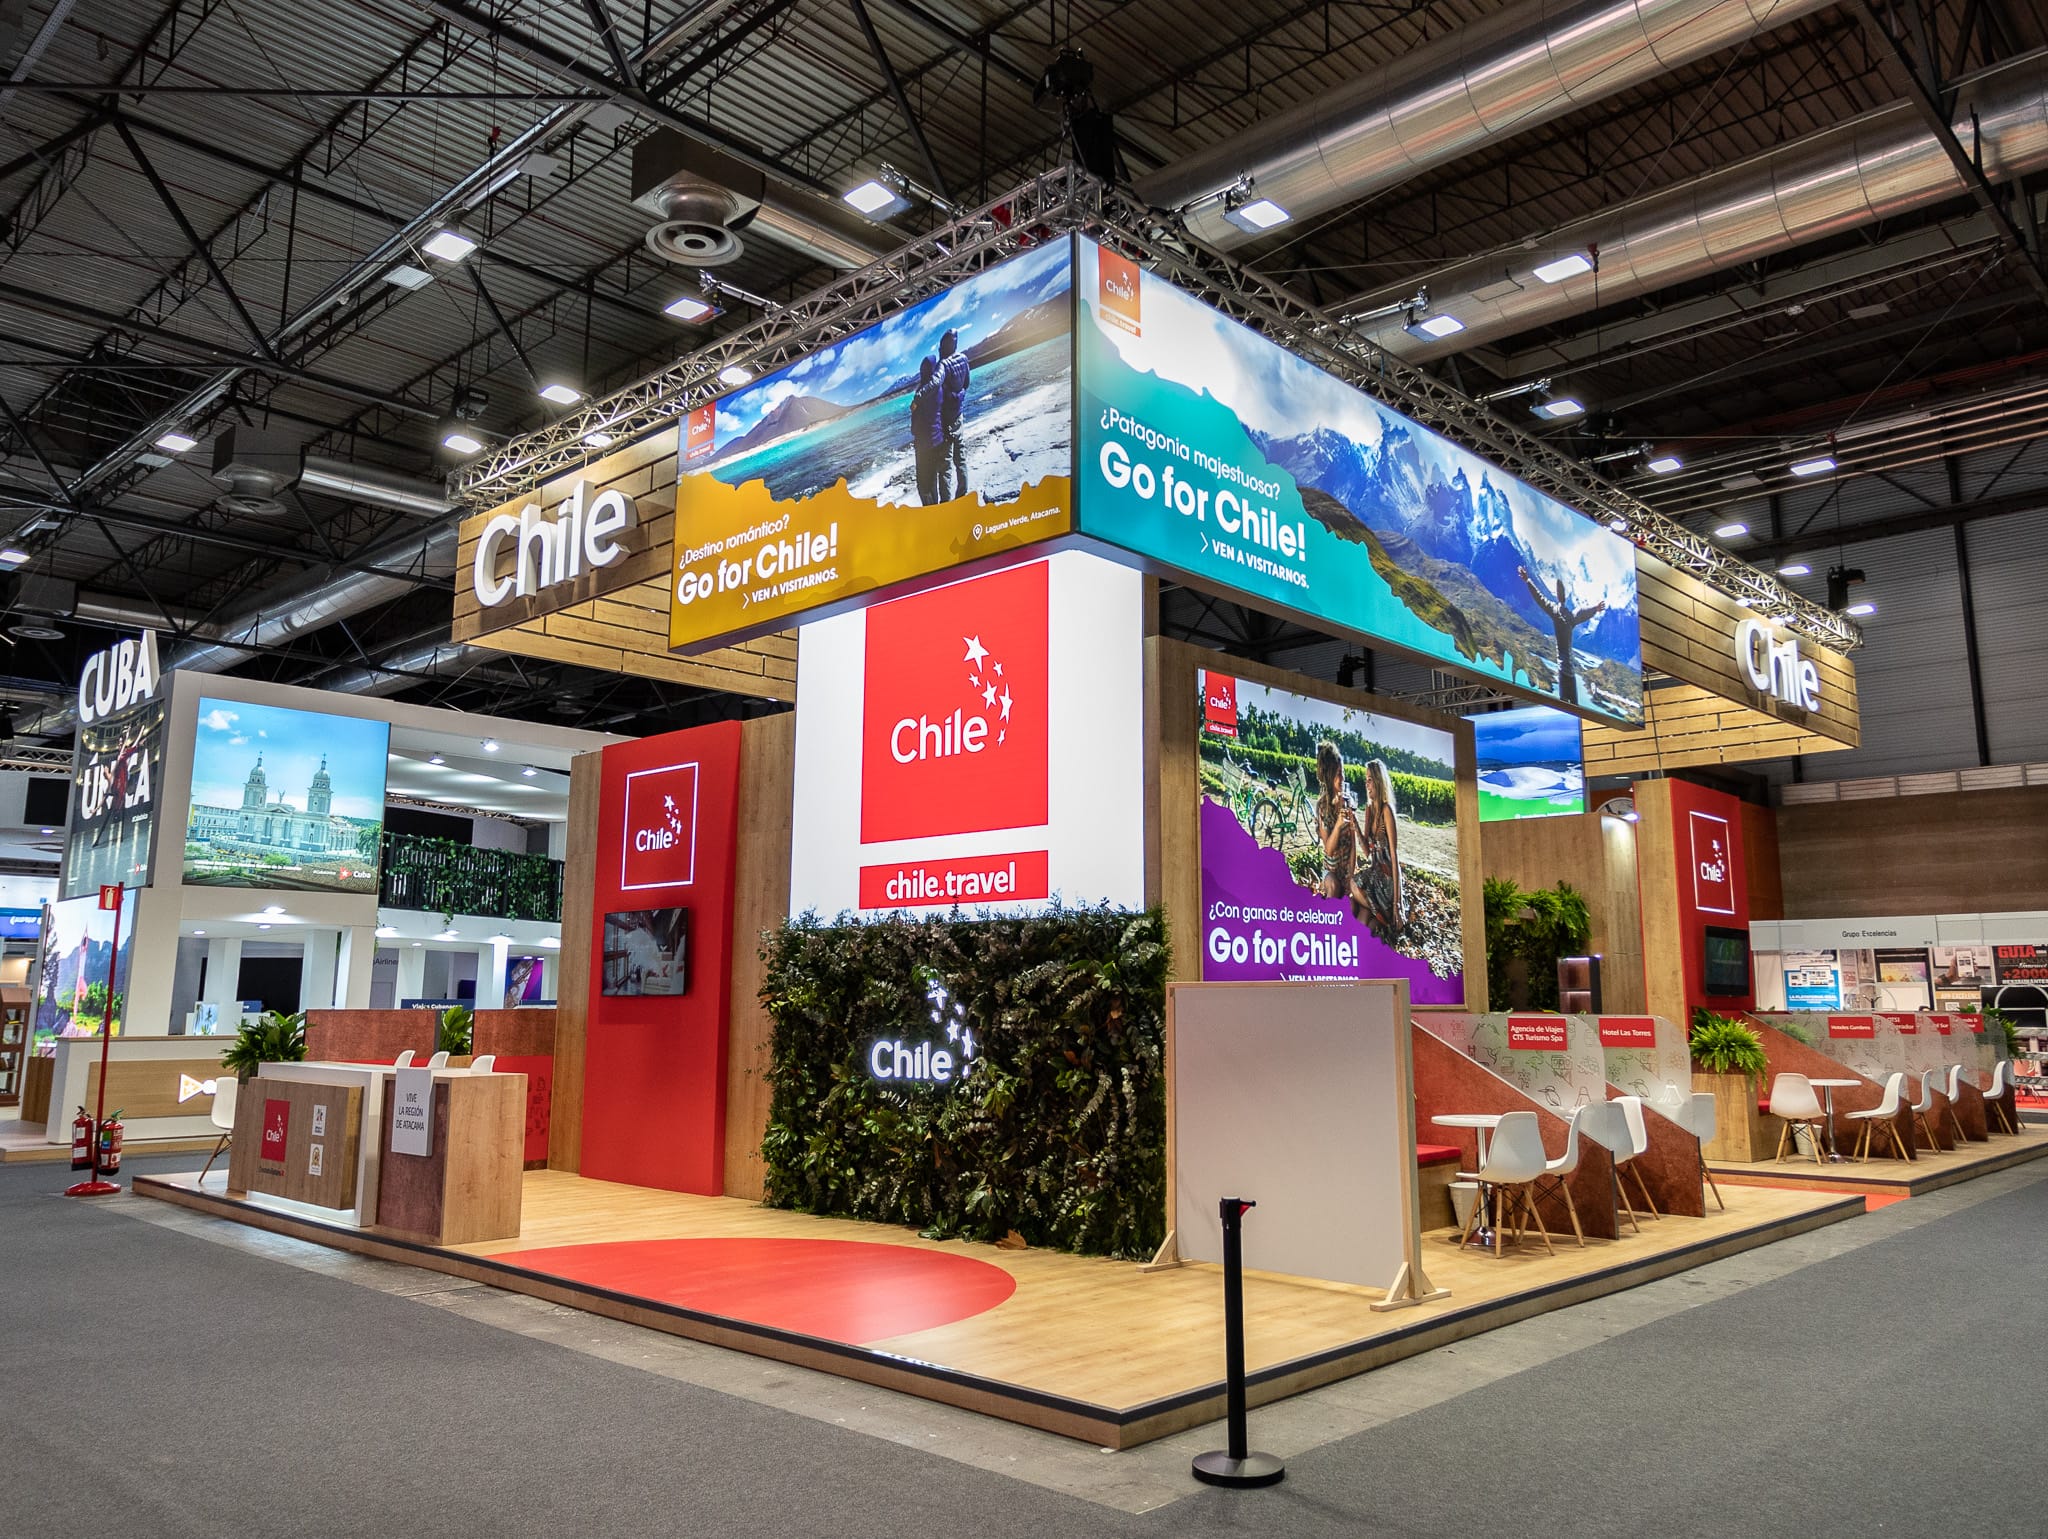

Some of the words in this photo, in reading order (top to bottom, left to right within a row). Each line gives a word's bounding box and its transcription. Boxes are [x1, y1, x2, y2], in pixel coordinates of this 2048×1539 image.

[1105, 279, 1130, 301] Chile
[691, 422, 708, 436] Chile
[1100, 407, 1190, 461] ¿Patagonia
[1193, 449, 1281, 501] majestuosa?
[1100, 441, 1156, 500] Go
[1162, 465, 1209, 522] for
[1215, 490, 1306, 562] Chile!
[985, 521, 1009, 534] Laguna
[1008, 515, 1030, 527] Verde,
[1030, 507, 1061, 521] Atacama.
[474, 480, 634, 608] Chile
[679, 540, 724, 570] ¿Destino
[725, 513, 790, 550] romántico?
[677, 571, 714, 605] Go
[717, 559, 753, 593] for
[756, 522, 839, 579] Chile!
[1212, 539, 1235, 561] VEN
[1236, 549, 1245, 565] A
[1246, 554, 1310, 590] VISITARNOS.
[752, 589, 772, 603] VEN
[771, 589, 779, 600] A
[779, 568, 839, 595] VISITARNOS.
[79, 629, 153, 723] CUBA
[1736, 619, 1820, 712] Chile
[1210, 696, 1228, 710] Chile
[890, 707, 989, 764] Chile
[1209, 724, 1234, 735] chile.travel
[81, 748, 151, 821] ÚNCA
[635, 827, 674, 852] Chile
[353, 870, 372, 879] Cuba
[886, 861, 1016, 901] chile.travel
[1700, 862, 1723, 883] Chile
[1209, 901, 1240, 921] ¿Con
[1242, 907, 1278, 924] ganas
[1279, 906, 1295, 923] de
[1296, 908, 1344, 926] celebrar?
[1842, 930, 1860, 938] Grupo
[1208, 927, 1249, 964] Go
[1252, 929, 1287, 965] for
[1290, 931, 1359, 968] Chile!
[373, 957, 399, 967] Airline
[1510, 1025, 1536, 1034] Agencia
[1535, 1025, 1545, 1033] de
[1545, 1026, 1564, 1035] Viajes
[1512, 1033, 1524, 1041] CTS
[1525, 1034, 1550, 1042] Turismo
[1550, 1034, 1563, 1043] Spa
[1632, 1029, 1652, 1037] Torres
[871, 1040, 953, 1080] Chile
[406, 1093, 417, 1103] VIVE
[398, 1106, 405, 1116] LA
[405, 1106, 424, 1117] REGIÓN
[266, 1129, 280, 1143] Chile
[395, 1119, 403, 1129] DE
[402, 1120, 425, 1132] ATACAMA
